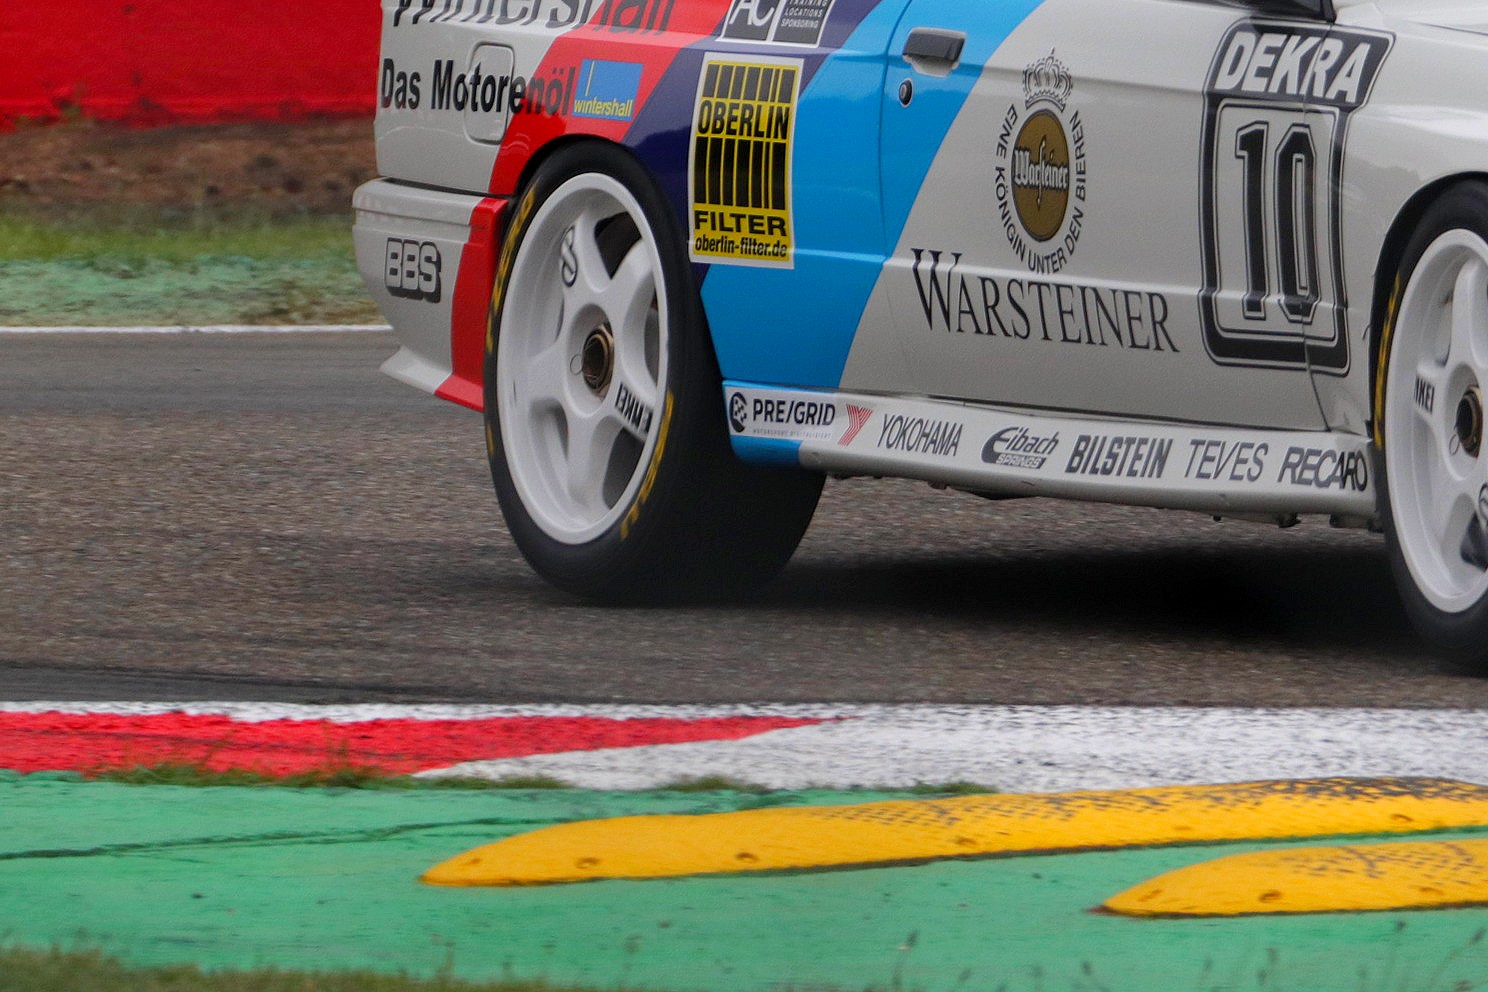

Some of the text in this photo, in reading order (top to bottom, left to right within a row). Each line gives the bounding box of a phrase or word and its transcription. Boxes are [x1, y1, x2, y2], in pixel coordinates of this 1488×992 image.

[780, 18, 819, 29] SPONSORING
[784, 7, 823, 18] LOCATIONS
[380, 58, 576, 116] Das Motorenöl
[1214, 30, 1371, 105] DEKRA
[574, 98, 633, 118] wintershall
[698, 99, 790, 140] OBERLIN
[994, 103, 1087, 276] EINE KÖNIGIN UNTER DEN BIEREN
[694, 210, 787, 236] FILTER
[1234, 121, 1321, 326] 10
[695, 234, 788, 258] oberlin-filter.de
[385, 237, 442, 303] BBS
[911, 248, 1181, 353] WARSTEINER
[752, 399, 836, 427] PRE/GRID
[877, 413, 964, 457] YOKOHAMA
[981, 426, 1058, 469] Eibach
[1065, 434, 1174, 478] BILSTEIN
[995, 454, 1043, 469] SPRINGS
[1184, 439, 1269, 482] TEVES
[1277, 446, 1369, 492] RECARO
